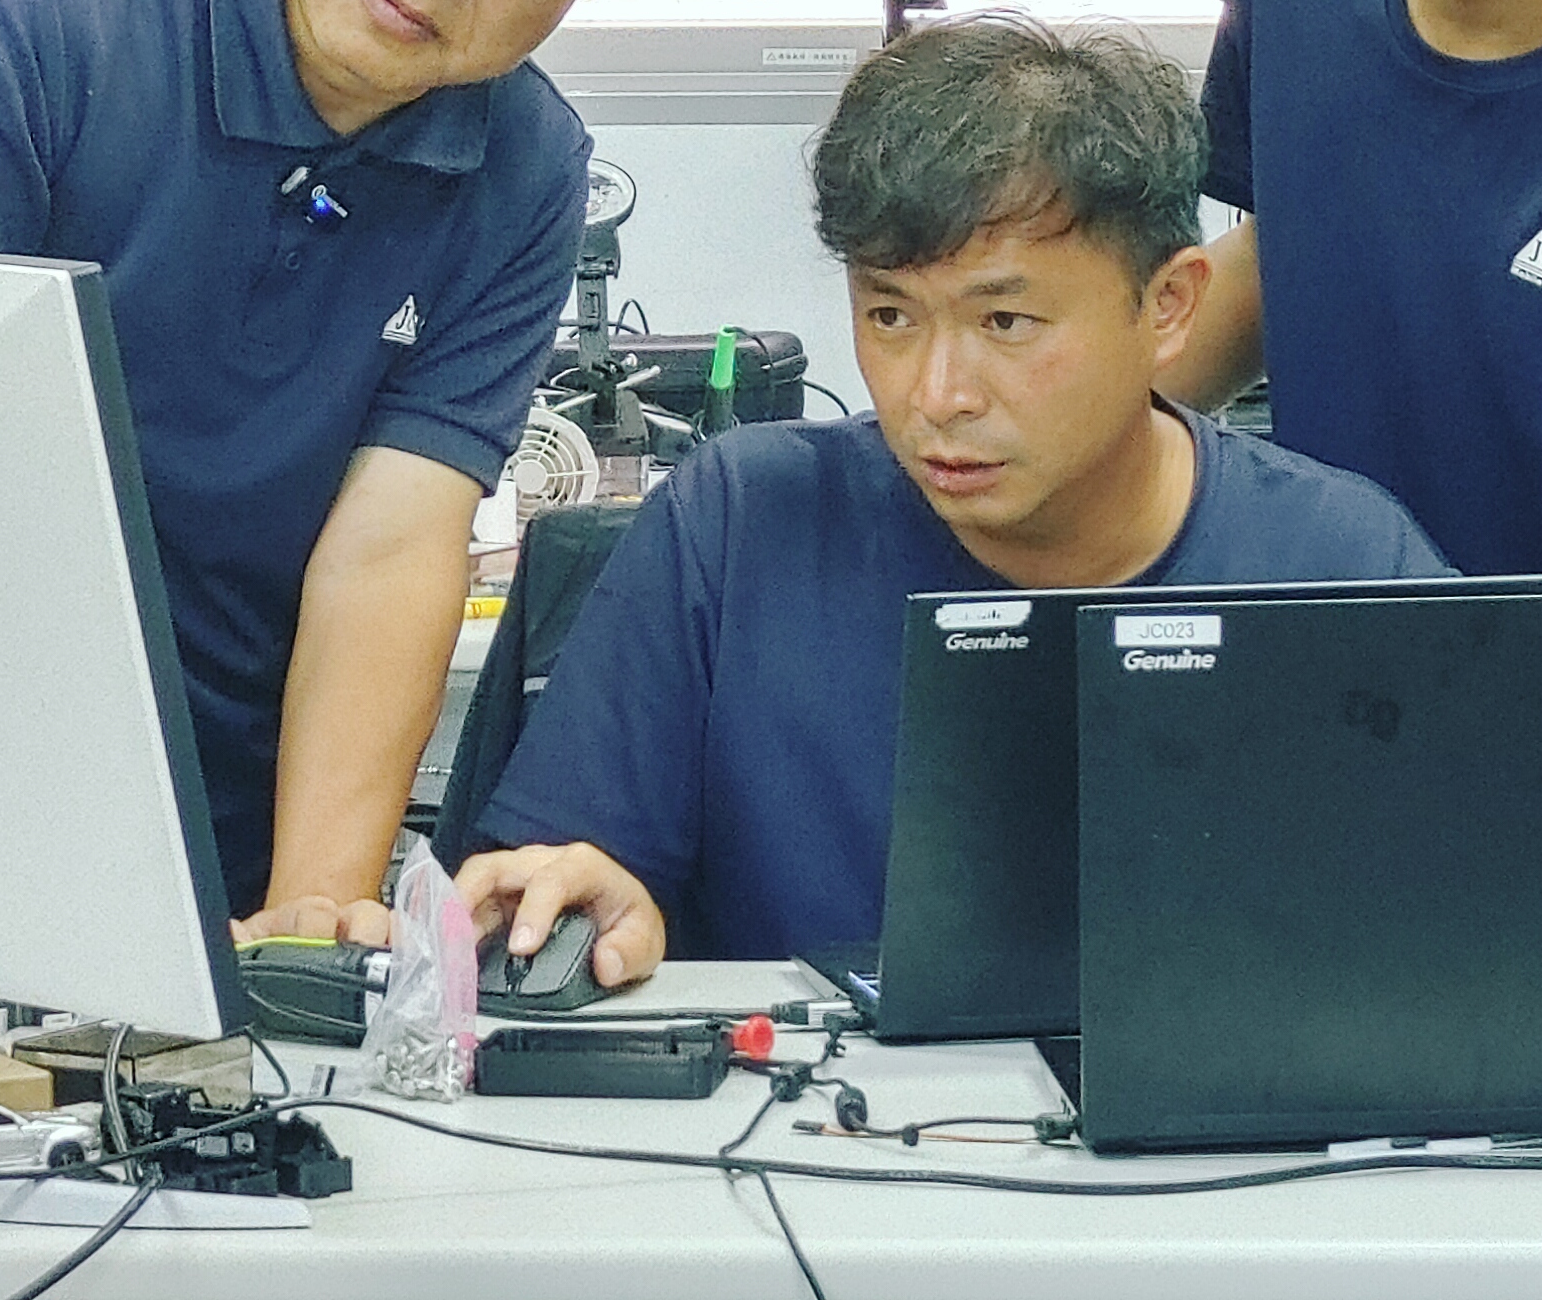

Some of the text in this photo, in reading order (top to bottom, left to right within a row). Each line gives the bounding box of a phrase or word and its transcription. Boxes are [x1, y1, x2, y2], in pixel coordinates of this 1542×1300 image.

[1139, 621, 1195, 639] JC023
[945, 631, 1030, 651] Genuine
[1123, 648, 1217, 671] Genuine
